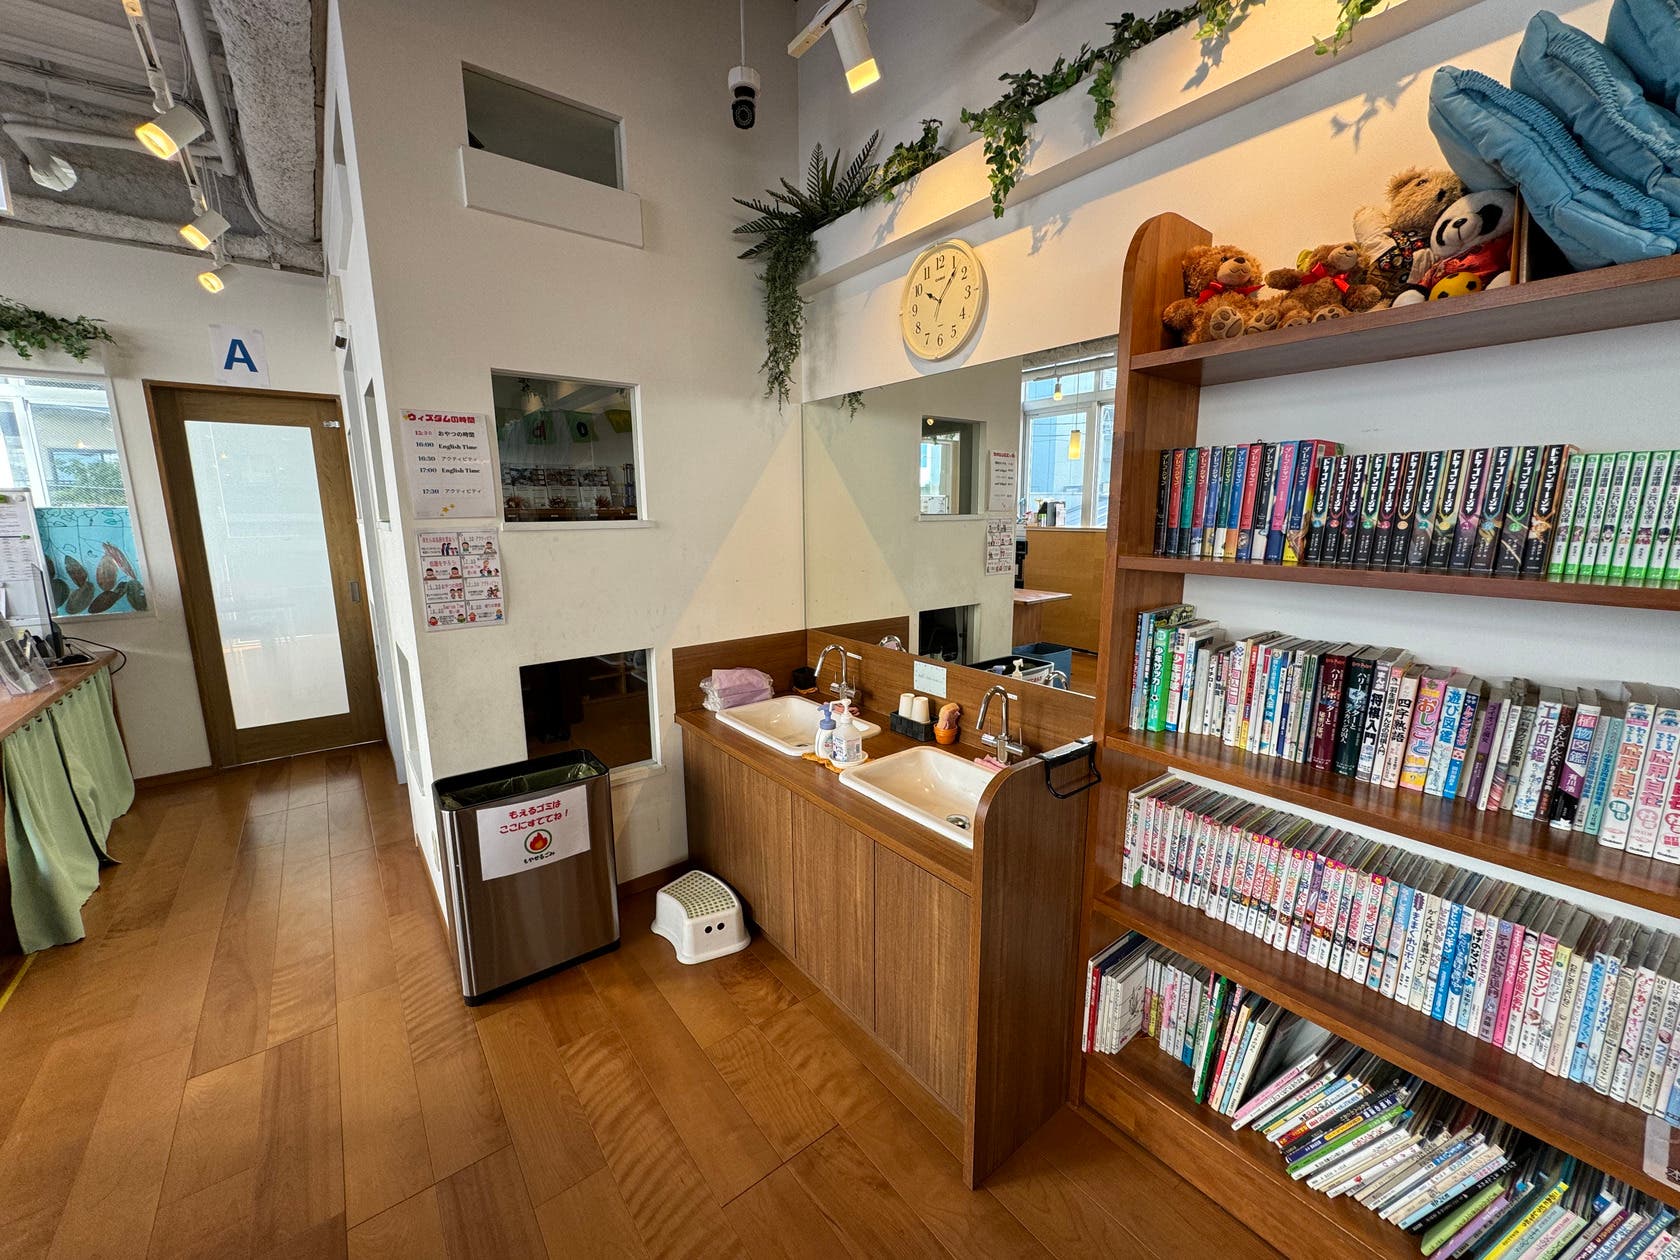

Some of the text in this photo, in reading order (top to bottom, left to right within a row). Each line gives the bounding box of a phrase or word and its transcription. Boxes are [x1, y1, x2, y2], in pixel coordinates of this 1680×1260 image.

[915, 283, 923, 297] 10
[924, 266, 930, 280] 11
[936, 255, 945, 270] 12
[223, 339, 259, 373] A
[407, 413, 476, 424] ウィズダムの時間
[1317, 458, 1333, 513] ドラゴンラージャ
[1334, 456, 1349, 512] ドラゴンラージャ
[1350, 456, 1364, 513] ドラゴンラージャ
[1367, 455, 1383, 514] ドラゴンラージャ
[1384, 454, 1401, 513] ドラゴンラージャ
[1402, 453, 1420, 513] ドラゴンラージャ
[1422, 452, 1440, 514] ドラゴンラージャ
[1443, 451, 1462, 513] ドラゴンラージャ
[1465, 451, 1485, 513] ドラゴンラージャ
[1488, 449, 1509, 513] ドラゴンラージャ
[1516, 448, 1536, 514] ドラゴンラージャ
[1540, 447, 1560, 514] ドラゴンラージャ
[1151, 646, 1164, 693] 少年サッカー
[1363, 692, 1383, 746] 将棋入門
[1392, 699, 1412, 743] 四字熟語
[1411, 698, 1440, 757] おしごと
[1439, 688, 1463, 744] 遊び図鑑
[1530, 705, 1558, 763] 工作図鑑
[1569, 714, 1598, 765] 植物図鑑
[1611, 743, 1644, 800] 応用自在
[1639, 750, 1674, 808] 応用自在
[499, 808, 569, 835] ここにすててね！
[509, 799, 561, 820] もえるゴミは
[523, 851, 556, 864] もやせるごみ
[1404, 913, 1421, 971] きまぐれロボット
[1532, 949, 1554, 1009] 名犬ラッシー
